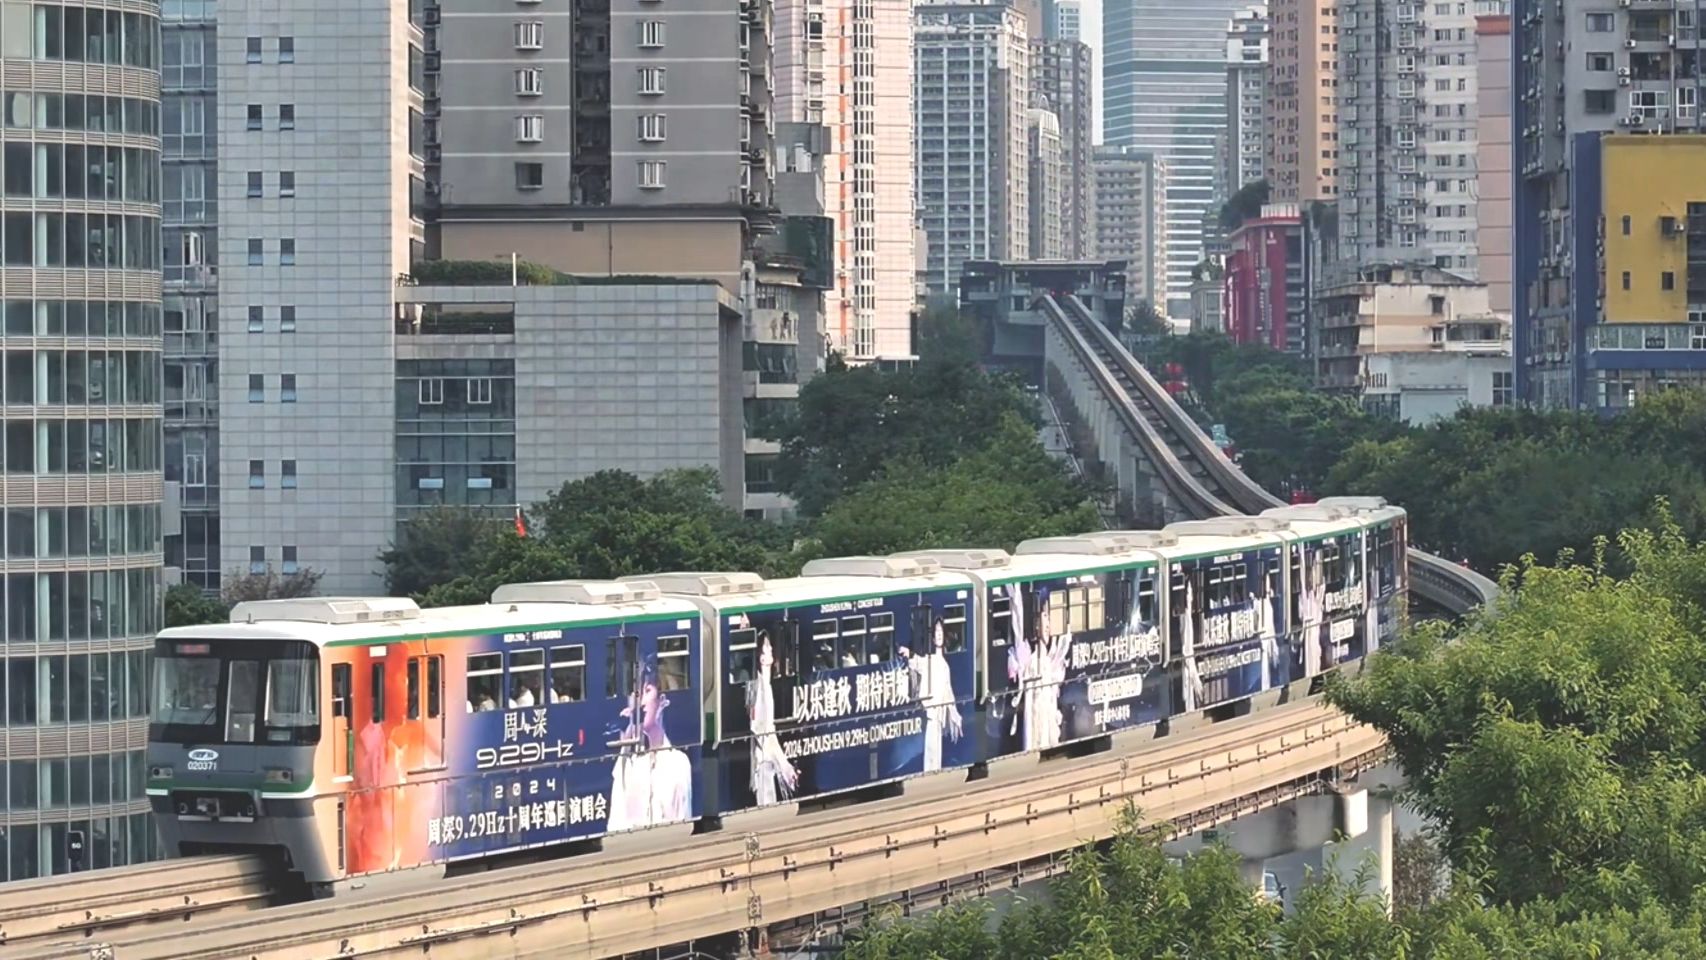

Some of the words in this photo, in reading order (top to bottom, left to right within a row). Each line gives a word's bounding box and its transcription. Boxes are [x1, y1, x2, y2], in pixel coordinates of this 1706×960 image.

[792, 676, 852, 723] 以乐逢秋
[855, 667, 911, 713] 期待同频
[504, 708, 547, 742] 周深
[782, 741, 803, 759] 2024
[803, 732, 844, 756] ZHOUSHEN
[869, 721, 902, 744] CONCERT
[901, 718, 923, 736] TOUR
[187, 760, 217, 771] 020371
[476, 739, 574, 769] 9.29Hz
